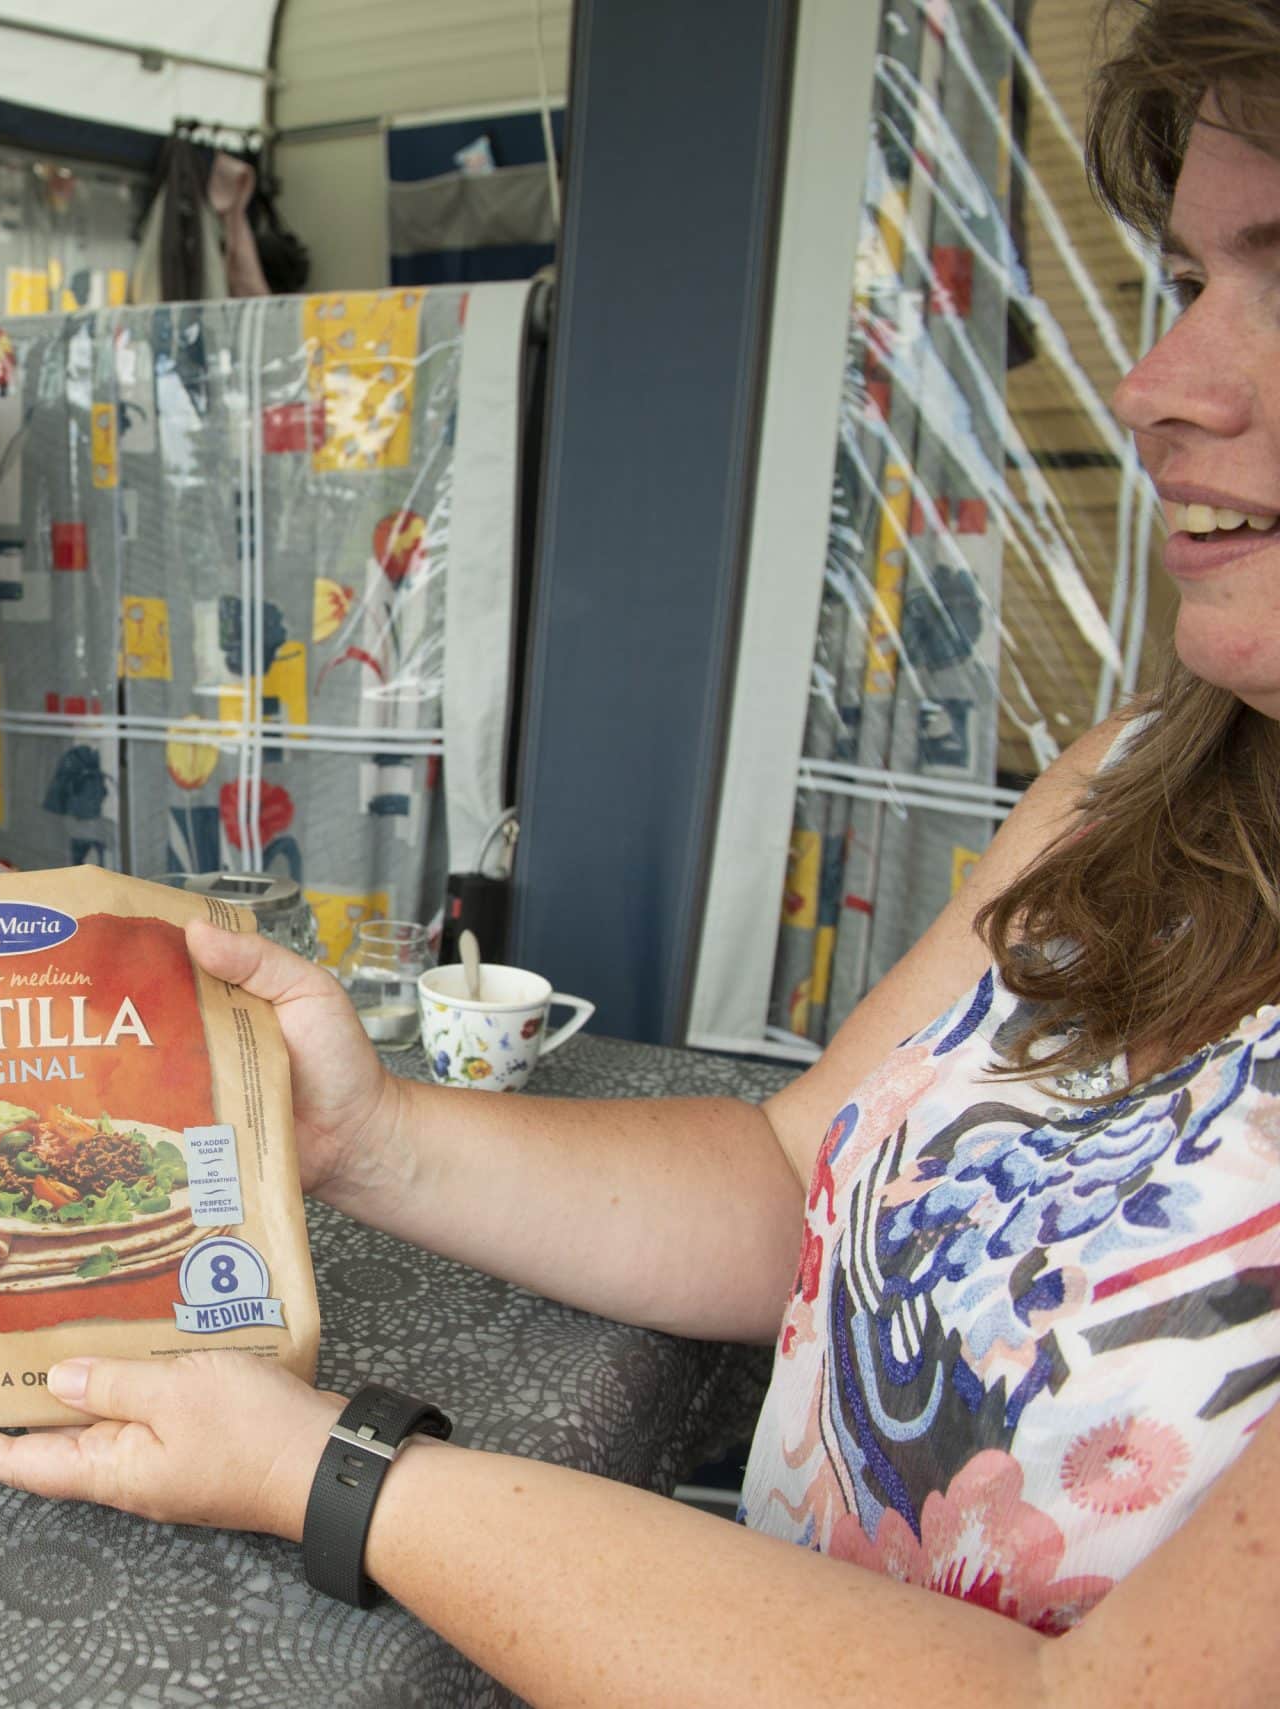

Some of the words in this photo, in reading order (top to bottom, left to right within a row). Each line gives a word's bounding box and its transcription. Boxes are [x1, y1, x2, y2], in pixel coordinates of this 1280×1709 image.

[10, 965, 93, 987] medium
[199, 1198, 232, 1206] PERFECT
[210, 1254, 239, 1294] 8
[196, 1301, 264, 1329] MEDIUM
